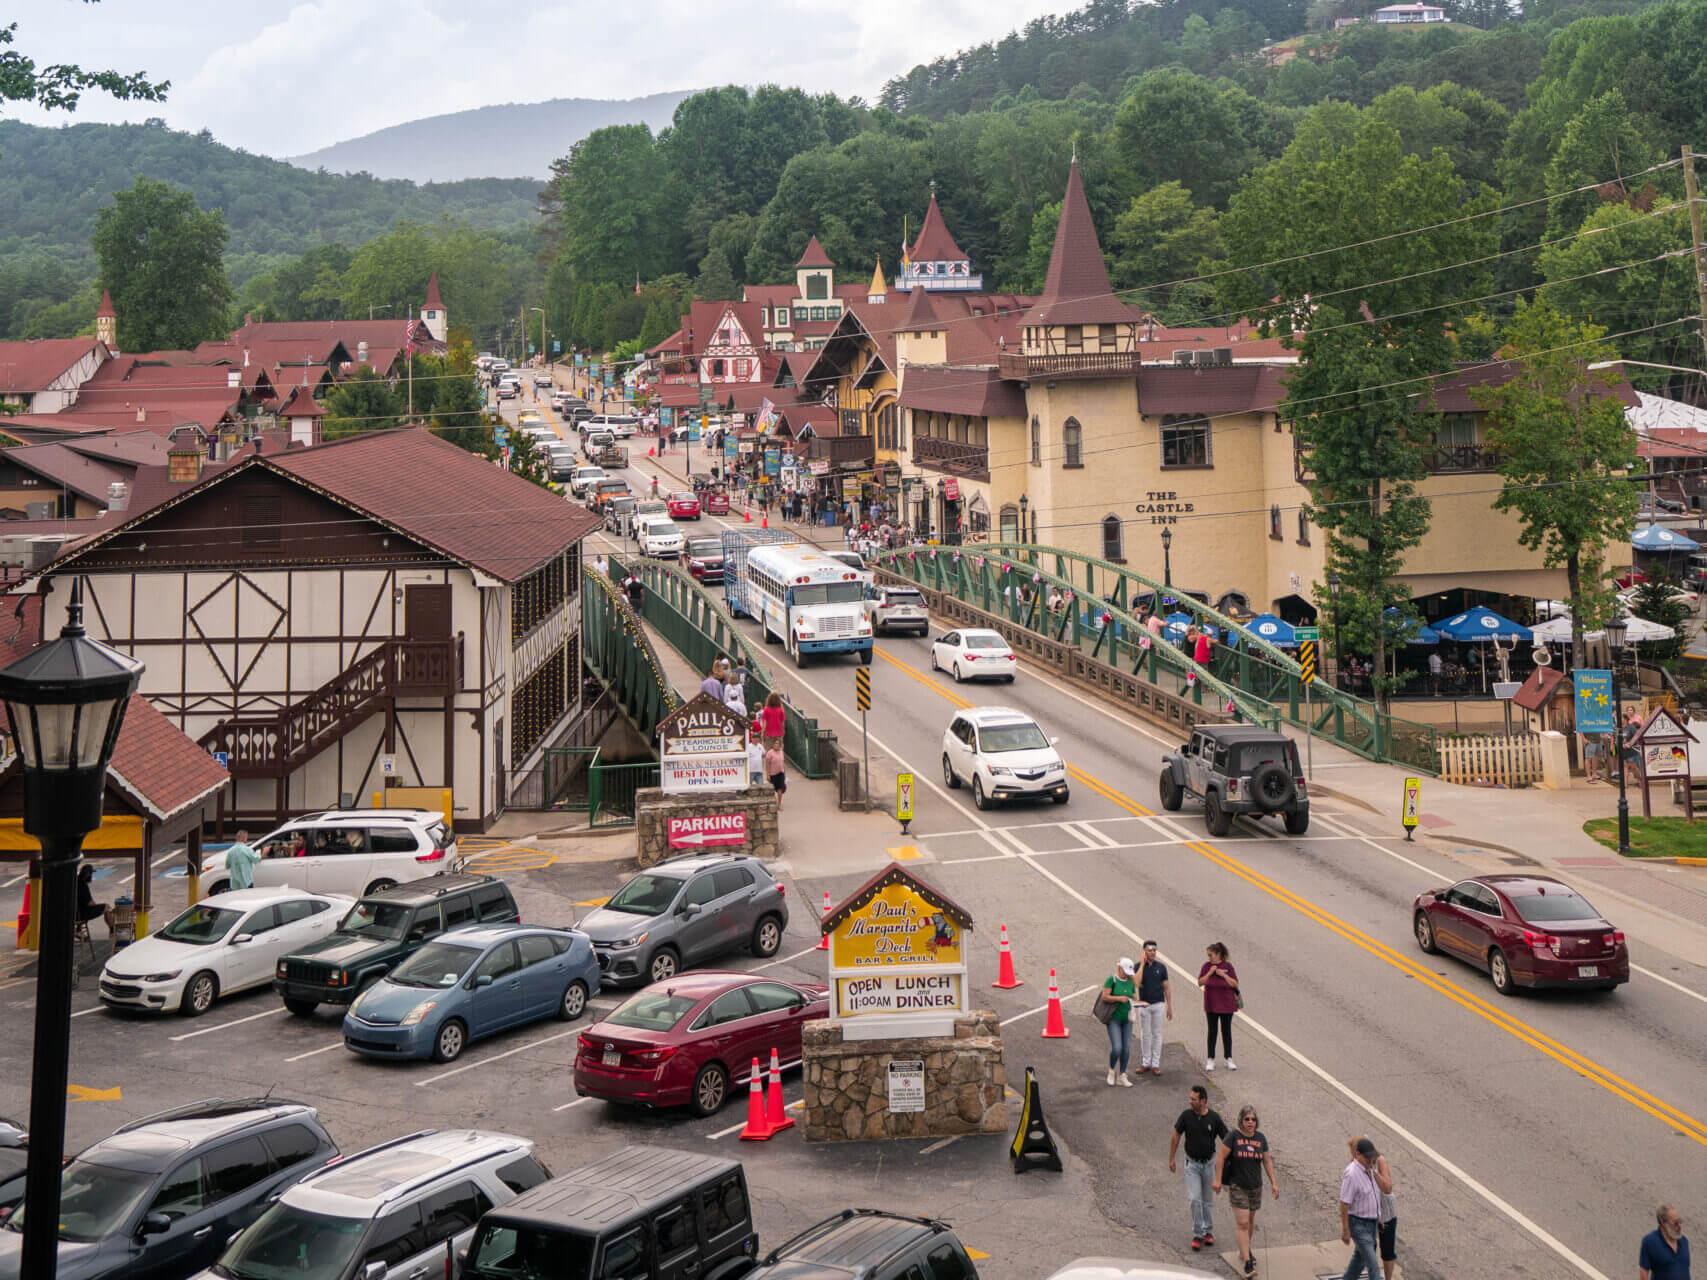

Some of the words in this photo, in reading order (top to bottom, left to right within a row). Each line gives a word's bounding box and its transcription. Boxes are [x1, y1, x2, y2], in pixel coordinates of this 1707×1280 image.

[1146, 491, 1177, 501] THE
[1135, 503, 1194, 513] CASTLE
[1151, 515, 1177, 525] INN
[676, 712, 736, 736] PAUL'S
[675, 737, 733, 746] STEAKHOUSE
[665, 761, 692, 770] STEAK
[674, 770, 695, 778] BEST
[700, 769, 708, 777] IN
[712, 768, 739, 777] TOWN
[688, 778, 709, 786] OPEN
[671, 815, 744, 833] PARKING
[870, 900, 917, 919] Paul's
[848, 918, 918, 938] Margarita
[874, 937, 912, 954] Deck
[855, 956, 881, 964] BAR
[899, 954, 937, 962] GRILL
[849, 977, 881, 995] OPEN
[895, 976, 950, 990] LUNCH
[896, 995, 955, 1008] DINNER
